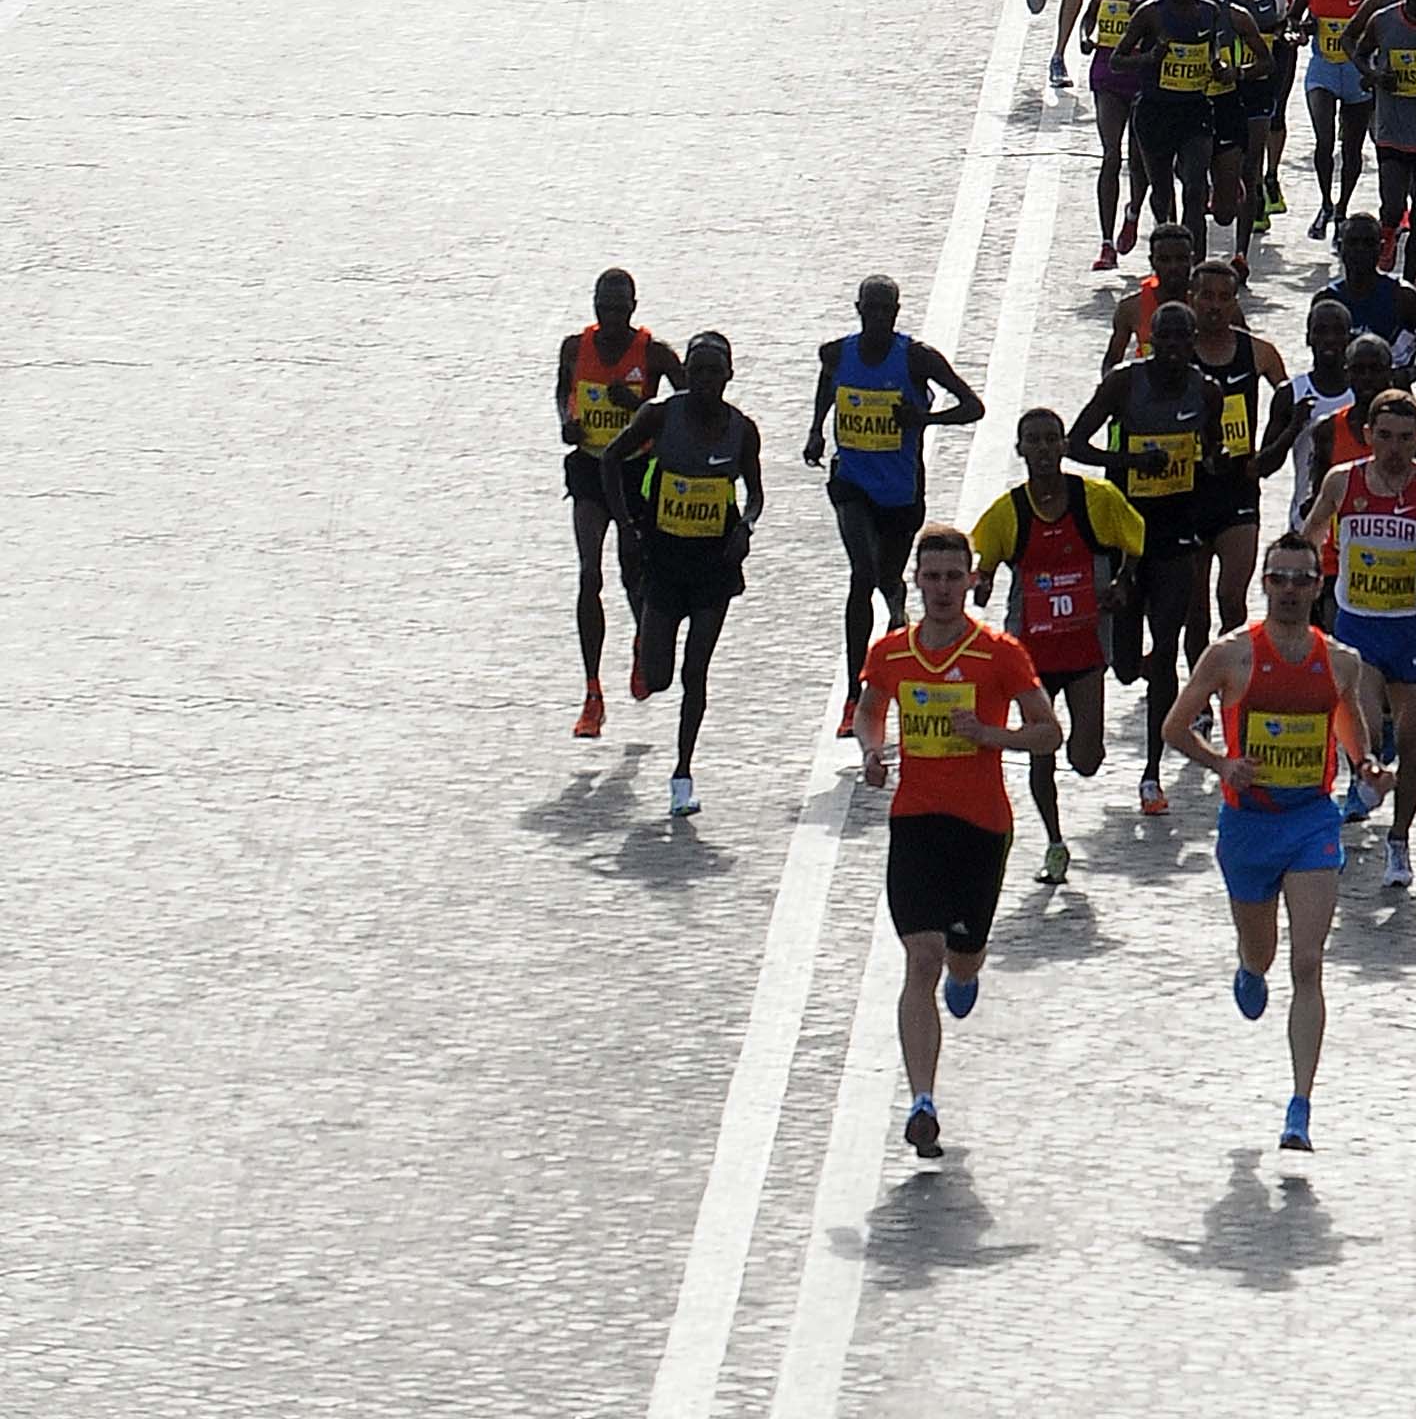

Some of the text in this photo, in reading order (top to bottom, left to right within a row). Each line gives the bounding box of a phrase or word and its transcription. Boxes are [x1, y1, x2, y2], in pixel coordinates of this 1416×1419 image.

[662, 498, 721, 521] KANDA
[1349, 517, 1416, 543] RUSSIA
[1049, 595, 1073, 617] 70
[902, 713, 952, 739] DAVYD
